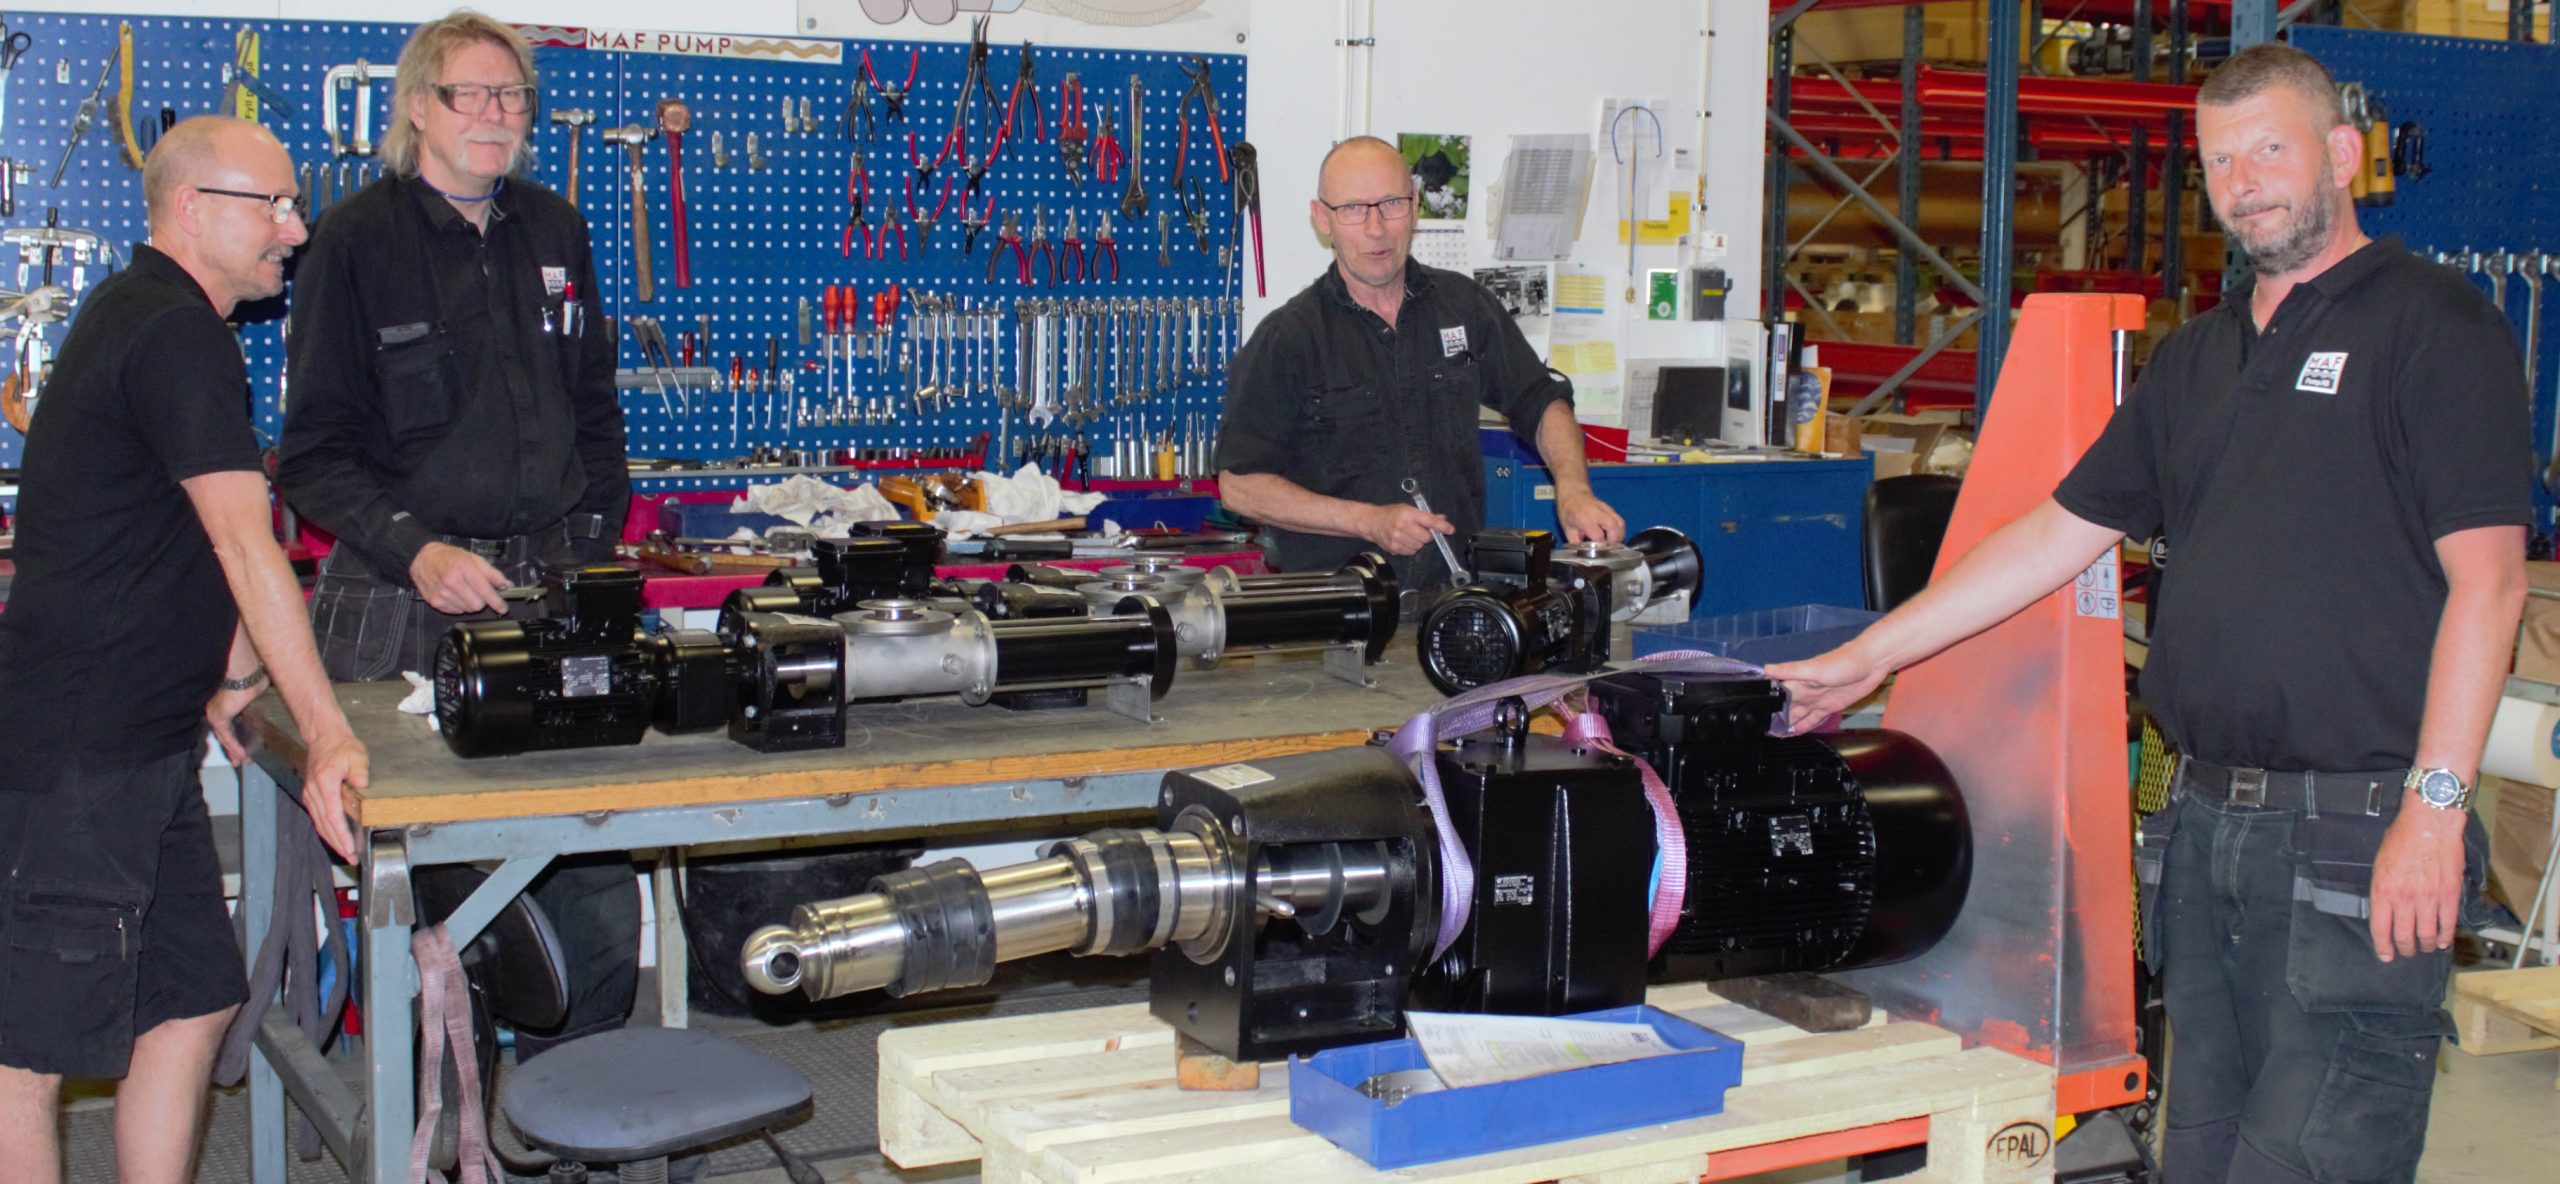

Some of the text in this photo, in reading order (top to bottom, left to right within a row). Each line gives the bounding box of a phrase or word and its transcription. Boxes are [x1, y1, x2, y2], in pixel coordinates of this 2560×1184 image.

[589, 30, 731, 55] MAF PUMP
[2307, 356, 2343, 369] MAF
